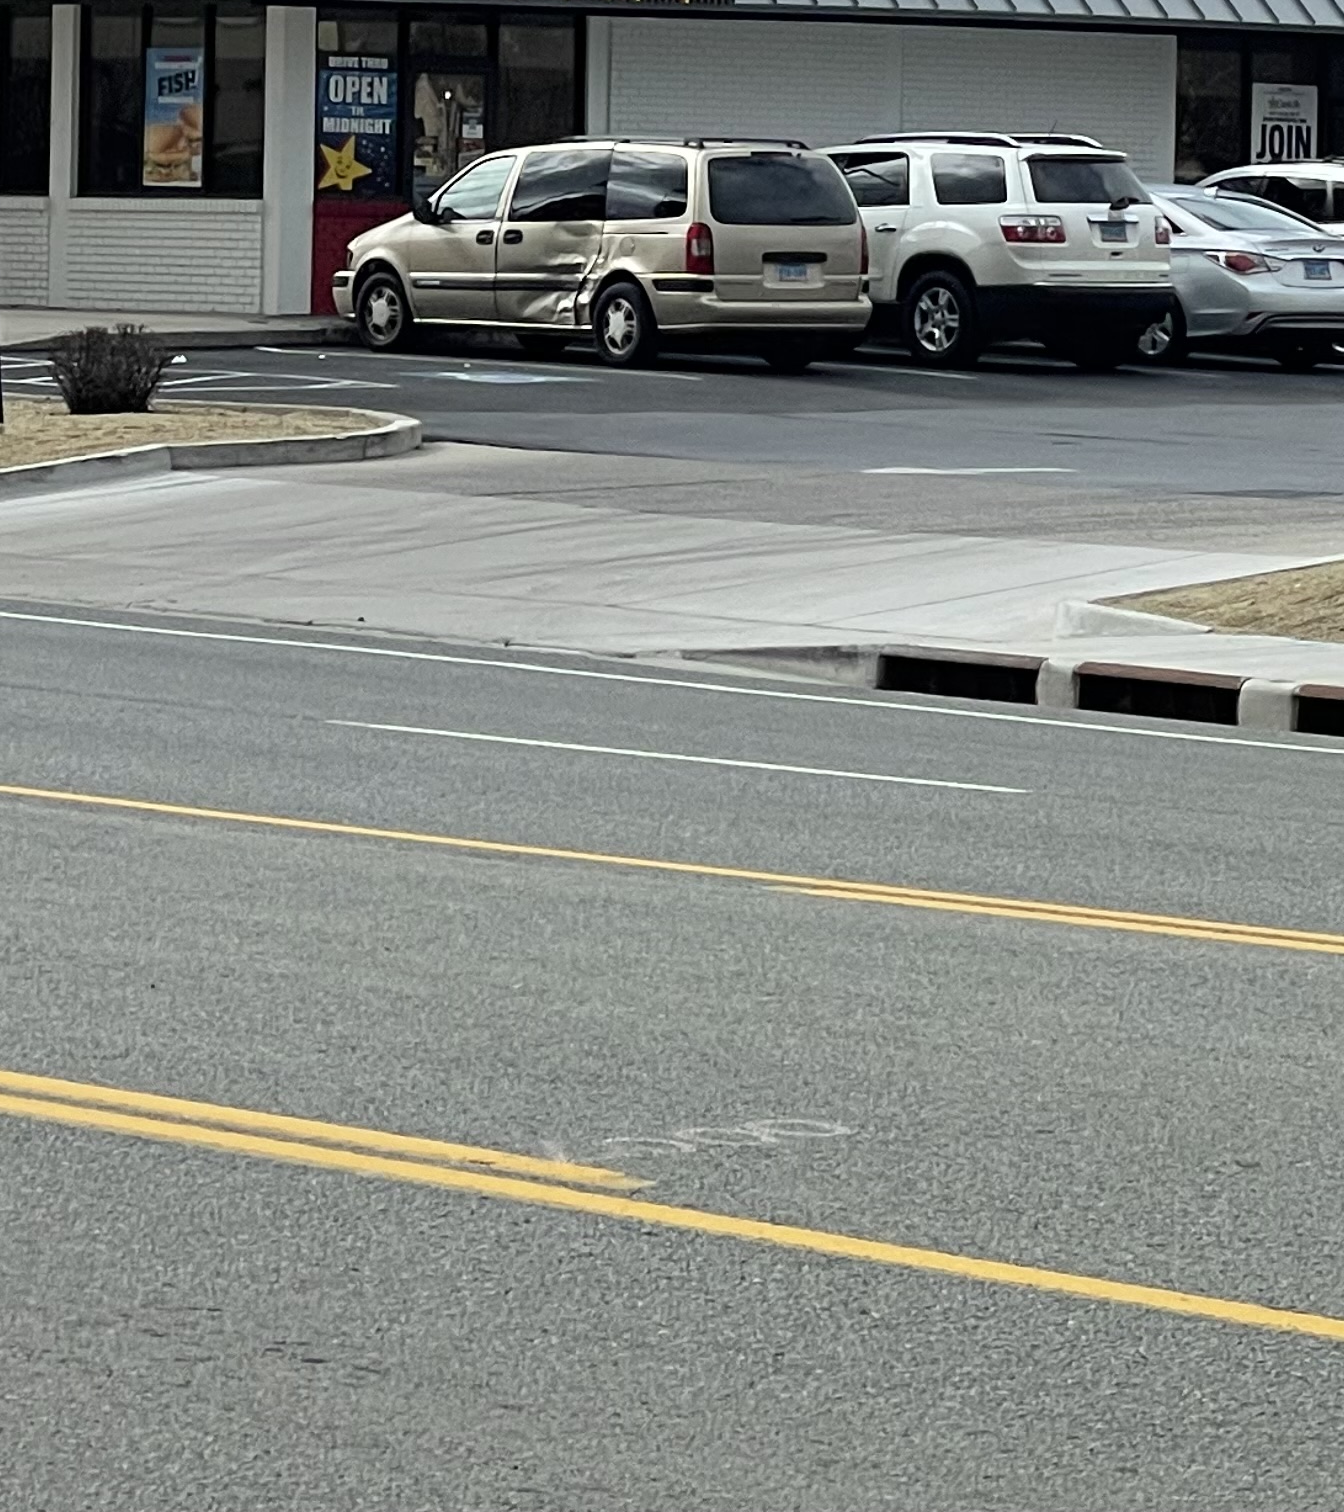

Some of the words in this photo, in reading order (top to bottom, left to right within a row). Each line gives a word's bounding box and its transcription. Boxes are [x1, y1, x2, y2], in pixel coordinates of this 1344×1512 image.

[157, 69, 197, 97] FISH
[328, 74, 389, 105] OPEN
[322, 116, 392, 135] MIDNIGHT
[1255, 123, 1312, 161] JOIN
